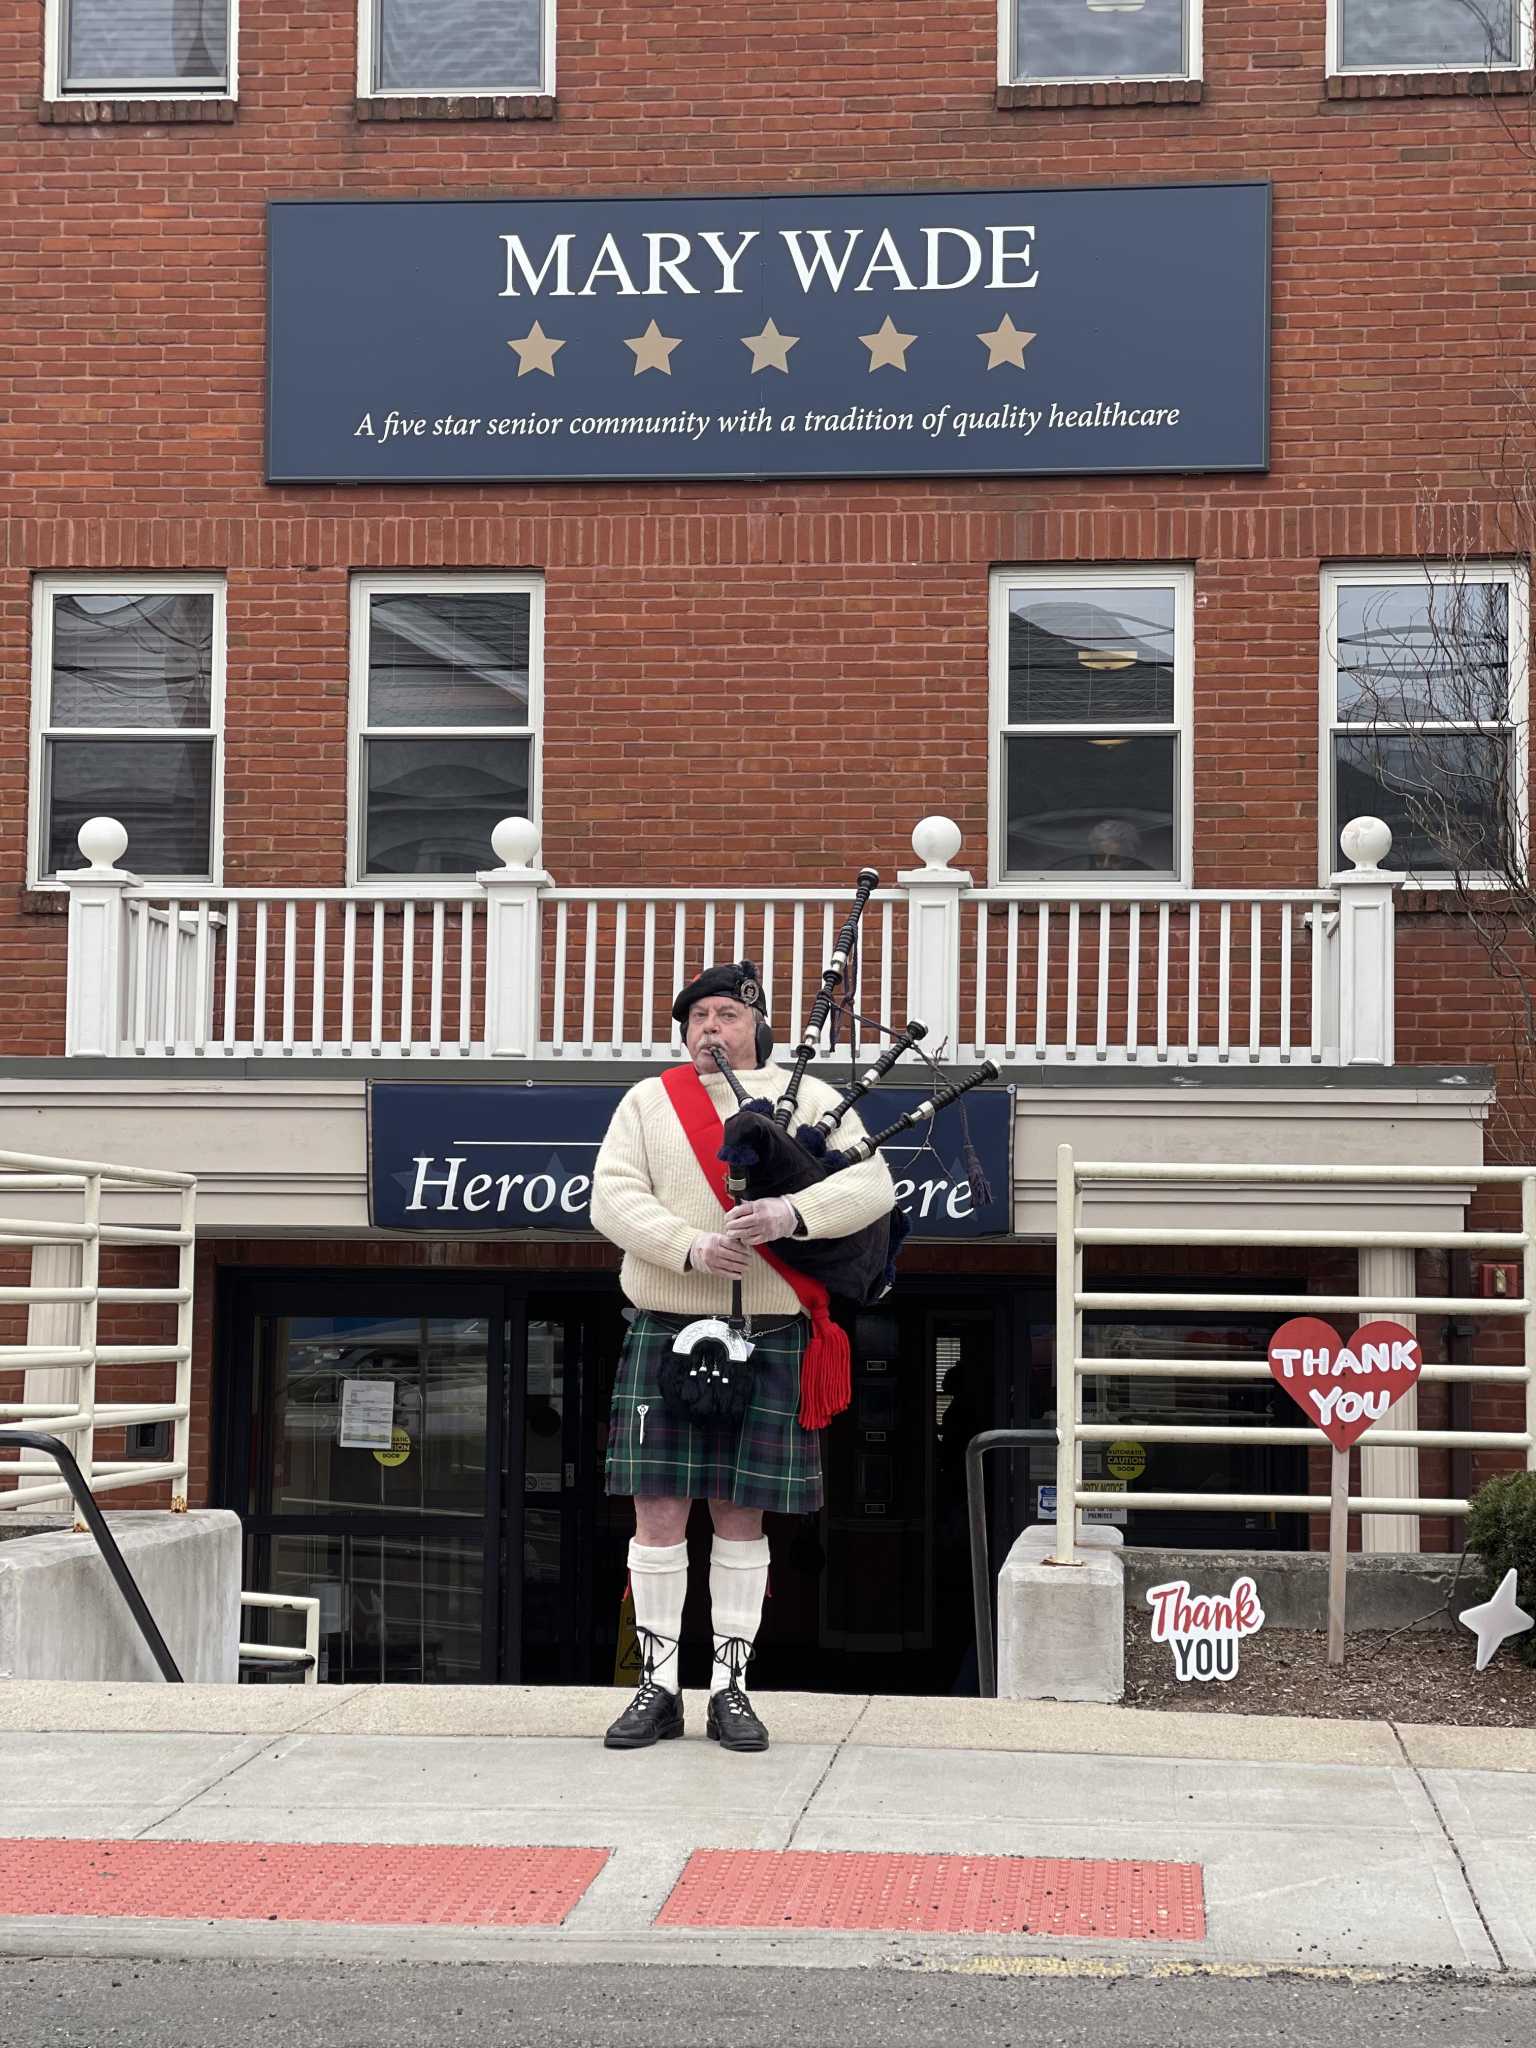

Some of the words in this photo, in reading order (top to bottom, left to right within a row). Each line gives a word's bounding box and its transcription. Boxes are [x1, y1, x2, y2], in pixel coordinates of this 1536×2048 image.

[498, 231, 761, 297] MARY
[778, 225, 1039, 293] WADE
[353, 412, 376, 437] A
[377, 410, 427, 444] five
[431, 414, 482, 436] star
[486, 412, 564, 436] senior
[569, 410, 711, 441] community
[717, 407, 773, 433] with
[780, 415, 796, 433] a
[804, 406, 914, 433] tradition
[921, 403, 952, 438] of
[952, 404, 1043, 438] quality
[1048, 401, 1181, 429] healthcare
[405, 1157, 591, 1213] Heroe
[893, 1179, 975, 1219] ere
[1271, 1339, 1418, 1378] THANK
[1308, 1386, 1391, 1426] YOU
[1107, 1456, 1145, 1465] CAUTION
[1152, 1583, 1260, 1636] Thank
[1175, 1638, 1234, 1676] YOU
